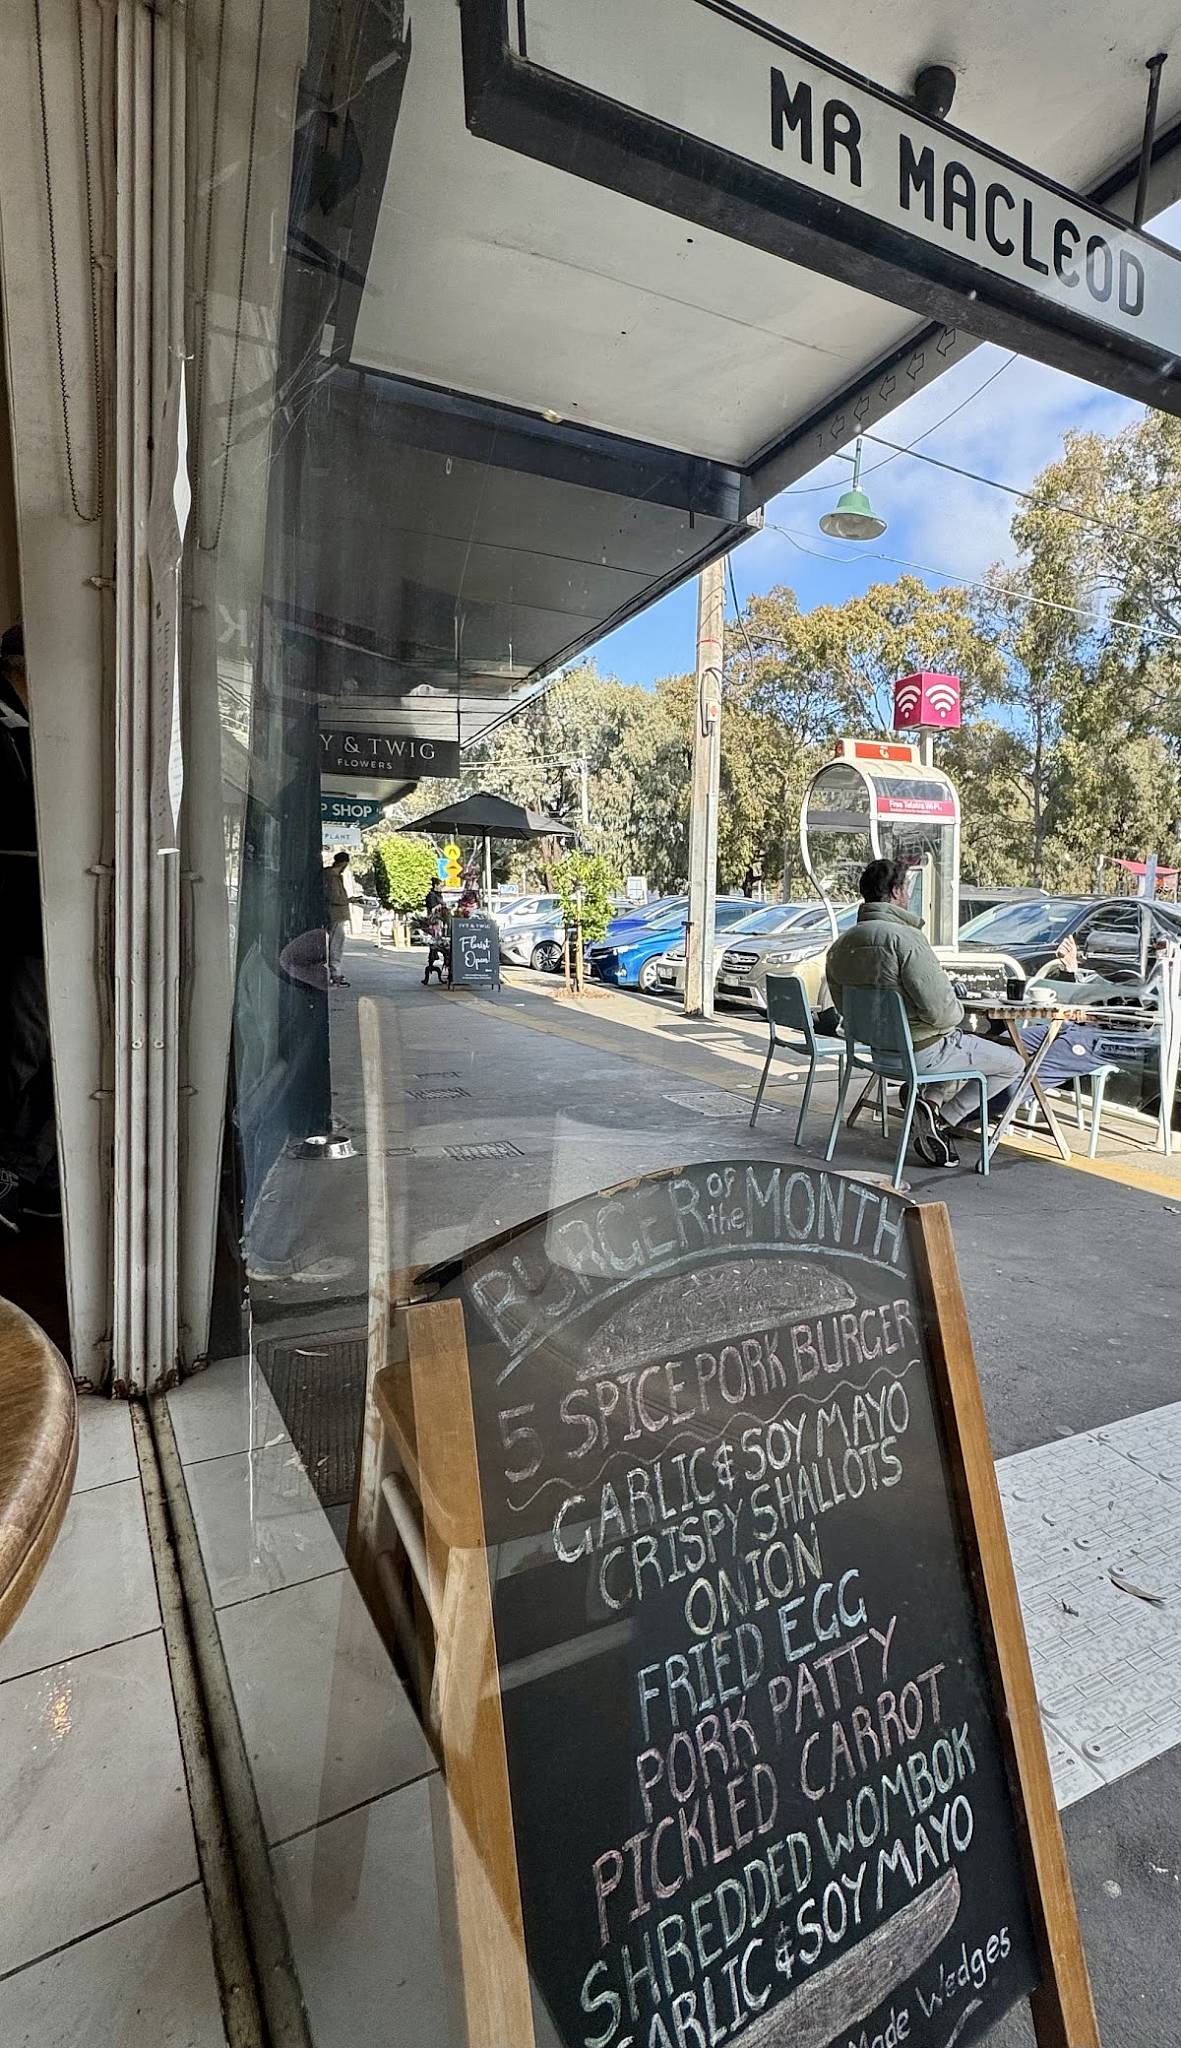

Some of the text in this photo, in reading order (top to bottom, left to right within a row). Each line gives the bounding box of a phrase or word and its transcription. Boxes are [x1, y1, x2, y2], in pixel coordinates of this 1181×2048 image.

[770, 66, 1146, 318] MR MACLEOD
[332, 802, 373, 818] SHOP
[337, 758, 393, 770] FLOWERS
[344, 736, 361, 753] &
[367, 738, 436, 760] TWIG
[705, 1165, 906, 1264] the MONTH
[498, 1298, 923, 1484] 5 SPICE PORK BURGER
[551, 1446, 718, 1562] GARLIC
[740, 1410, 808, 1482] SOY
[815, 1379, 910, 1458] MAYO
[599, 1434, 904, 1611] CRISPY SHALLOTS
[684, 1520, 824, 1637] ONION
[635, 1614, 898, 1824] PORK PATTY
[636, 1568, 868, 1743] FRIED EGG
[578, 1720, 978, 2046] SHREDDED WOMBOK
[590, 1661, 947, 1948] PICKLED CARROT
[617, 1937, 773, 2048] ARLIC
[796, 1861, 868, 1966] SOY
[875, 1794, 975, 1912] MAYO
[914, 1926, 1012, 2019] Wedges
